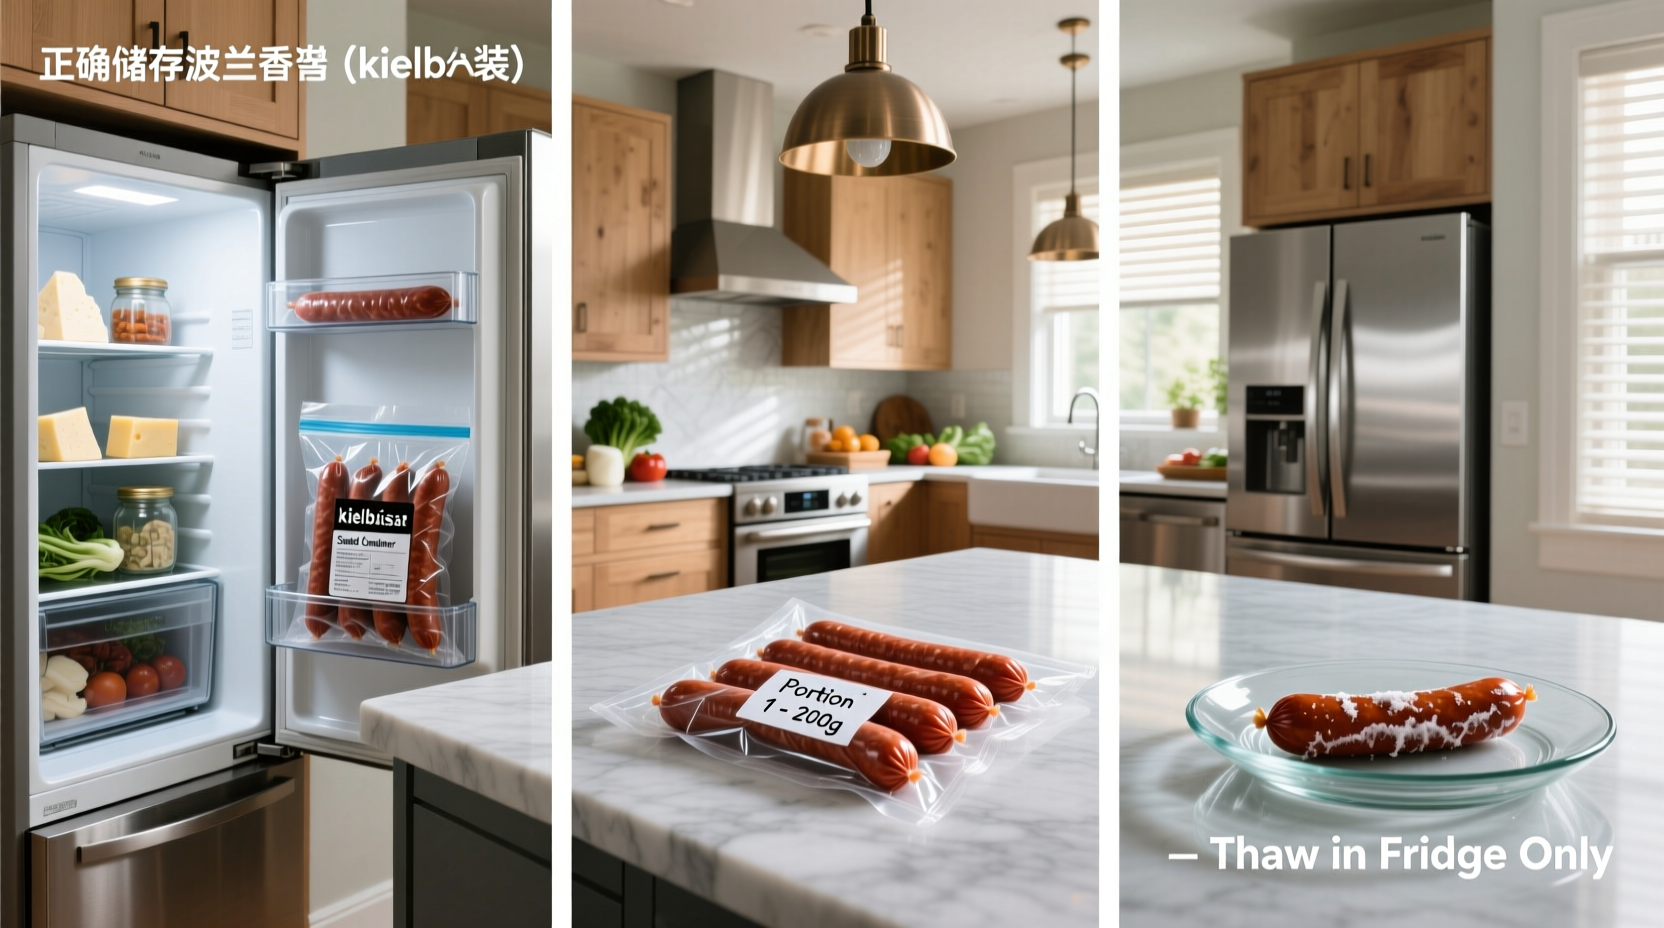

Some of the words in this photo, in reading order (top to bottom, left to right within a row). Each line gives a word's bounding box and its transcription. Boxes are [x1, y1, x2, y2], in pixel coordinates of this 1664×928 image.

[778, 677, 854, 709] Portion
[763, 698, 777, 713] 1
[792, 706, 843, 736] 200g
